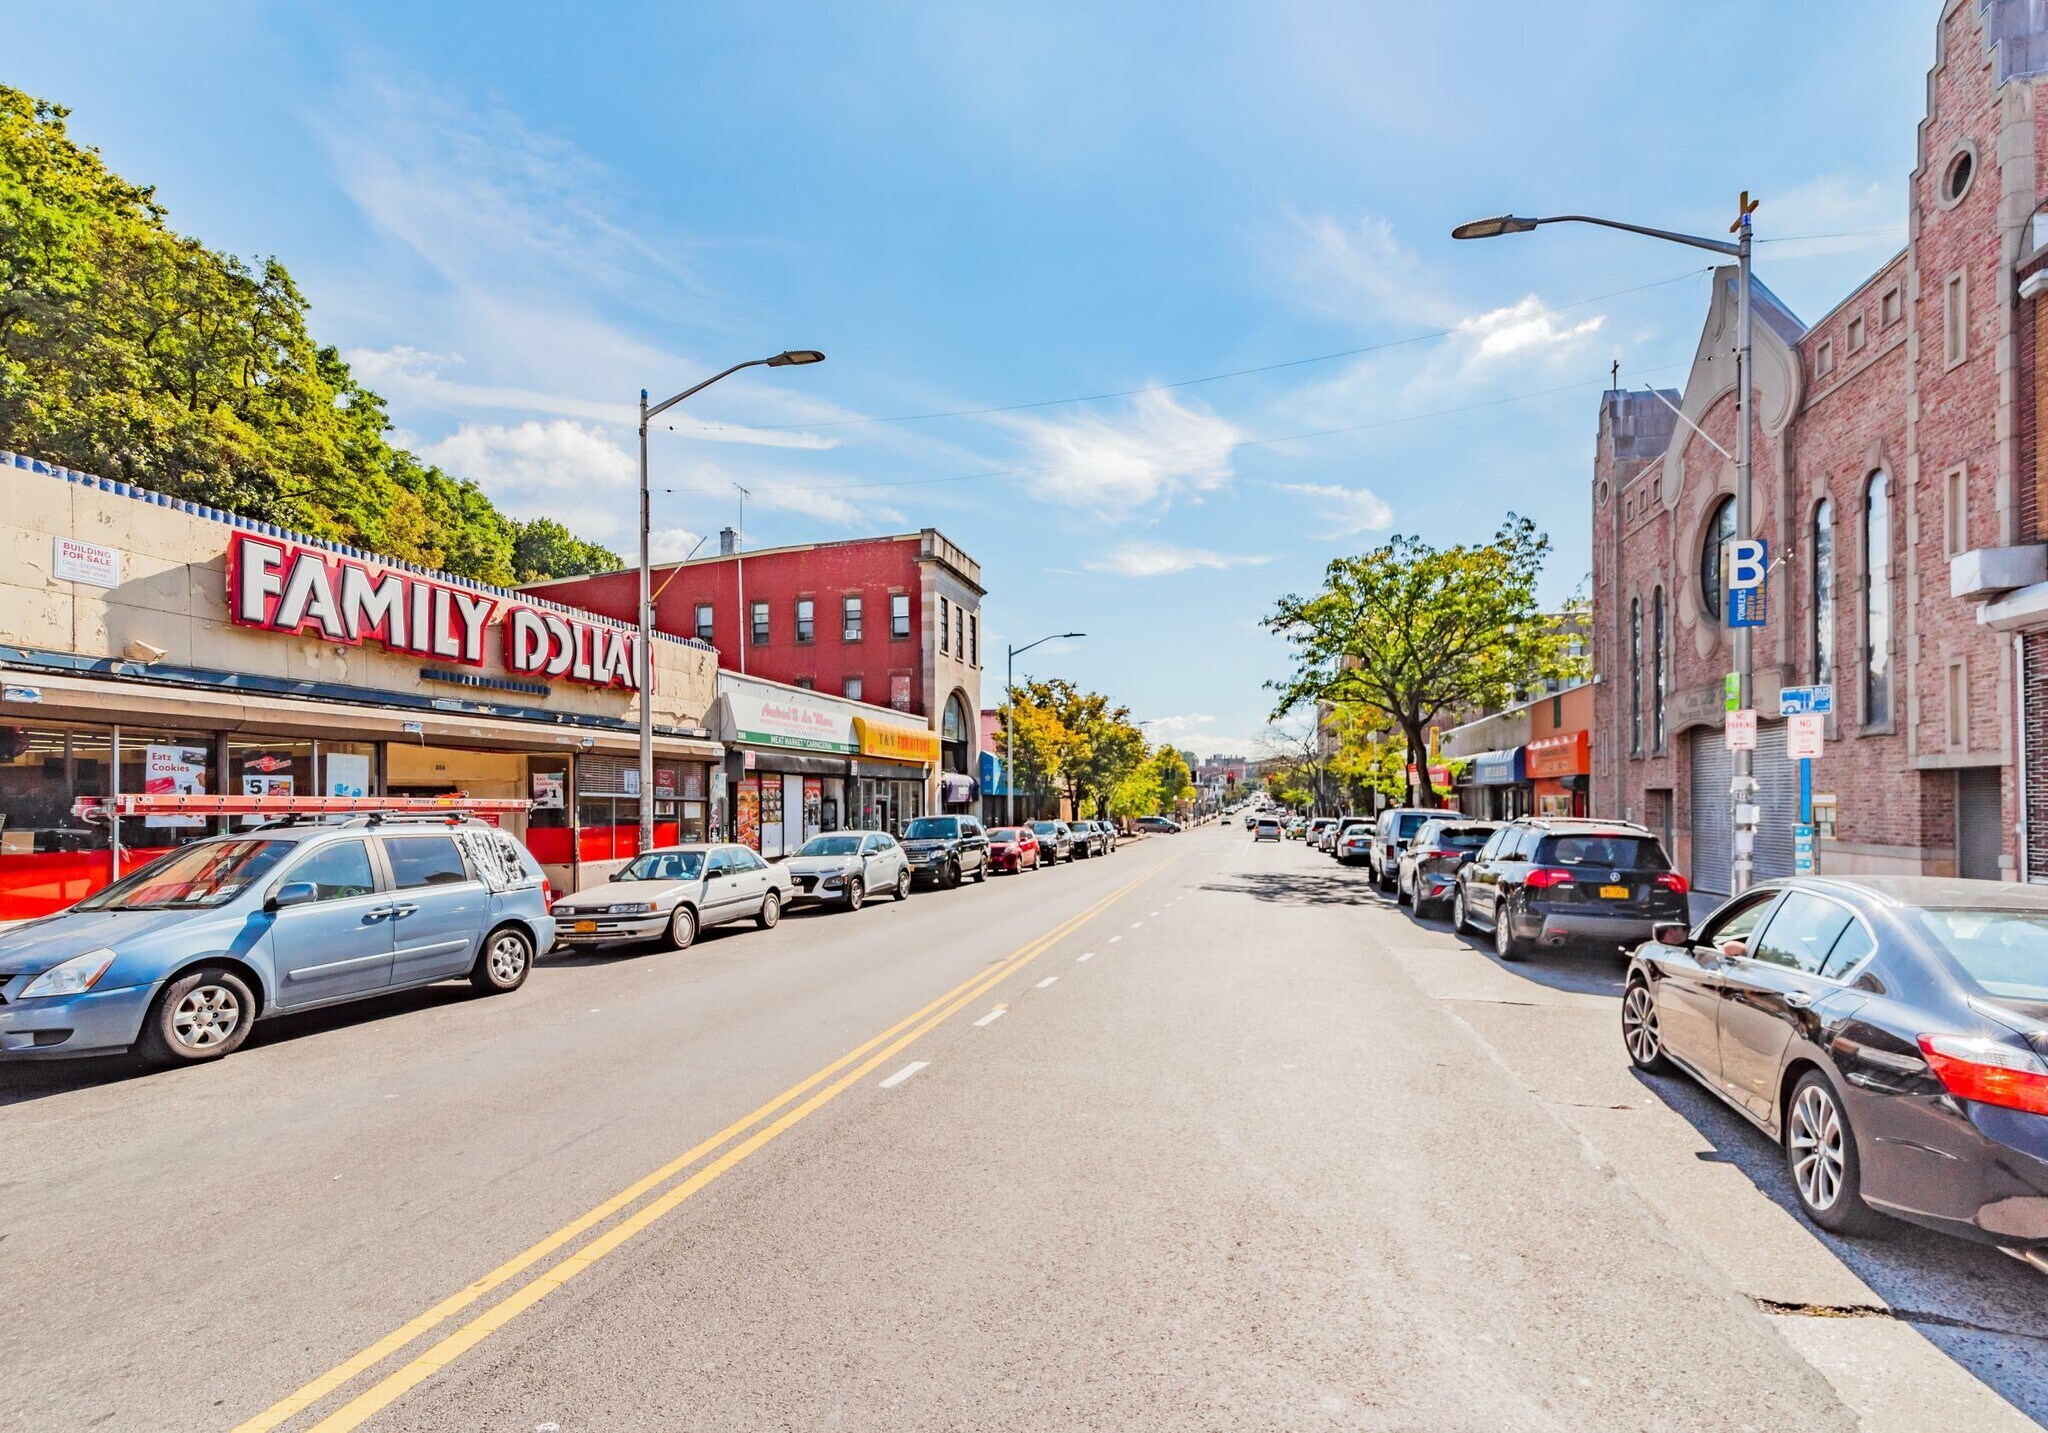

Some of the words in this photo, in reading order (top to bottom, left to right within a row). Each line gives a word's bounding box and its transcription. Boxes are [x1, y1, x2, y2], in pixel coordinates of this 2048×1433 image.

[63, 542, 112, 559] BUILDING
[63, 550, 84, 560] FOR
[87, 555, 112, 567] SALE
[1729, 540, 1765, 589] B
[241, 538, 492, 661] FAMILY
[1737, 589, 1747, 621] YONKERS
[1746, 595, 1756, 621] SOUTH
[1815, 687, 1830, 695] BUS
[771, 735, 784, 744] MEAT
[785, 737, 803, 747] MARKET
[806, 740, 832, 750] CARNICERIA
[897, 735, 930, 753] FURNITURE
[152, 752, 171, 761] Eatz
[152, 763, 190, 772] Cookies
[246, 778, 263, 795] $5
